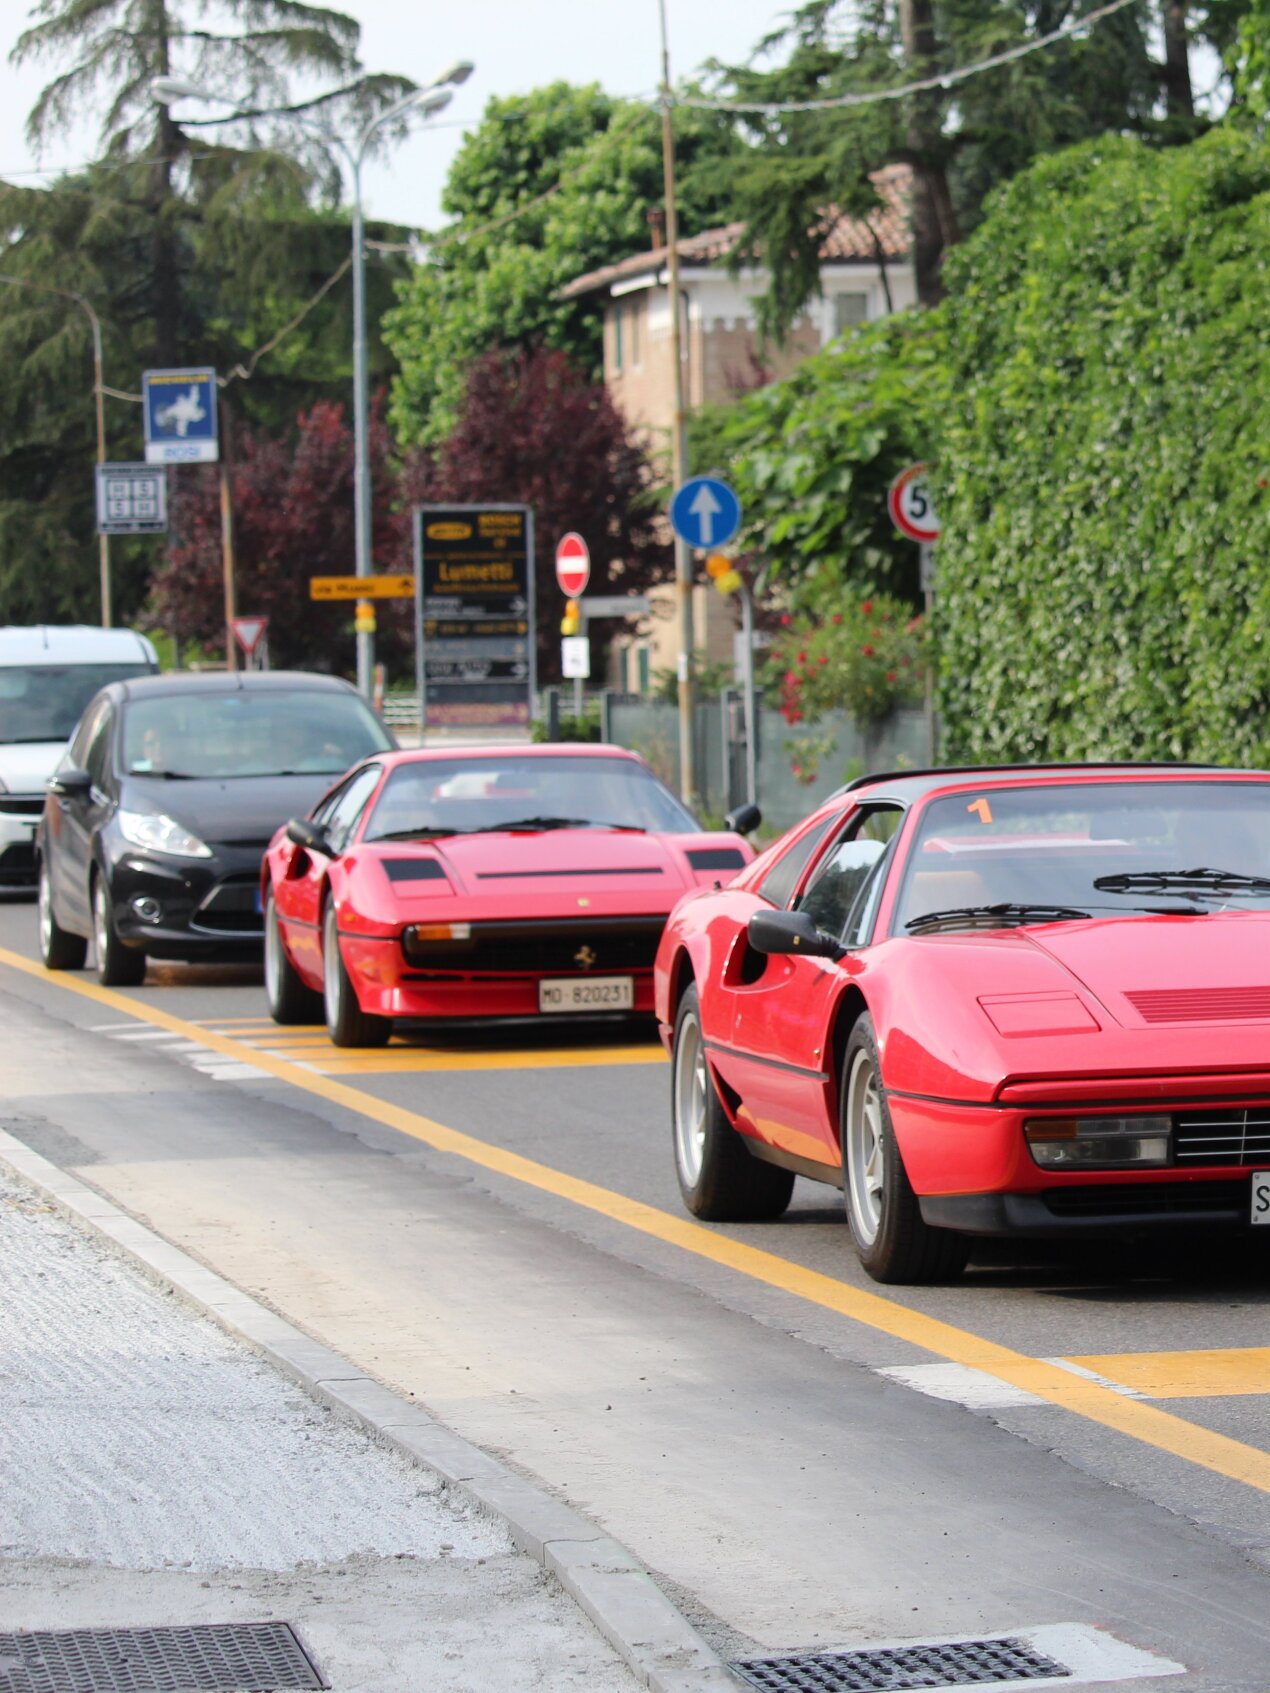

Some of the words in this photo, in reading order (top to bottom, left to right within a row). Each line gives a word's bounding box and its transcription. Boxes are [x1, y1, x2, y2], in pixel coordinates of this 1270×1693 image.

[438, 562, 514, 581] Lumetti
[967, 797, 993, 824] 1
[572, 985, 629, 1004] 820231
